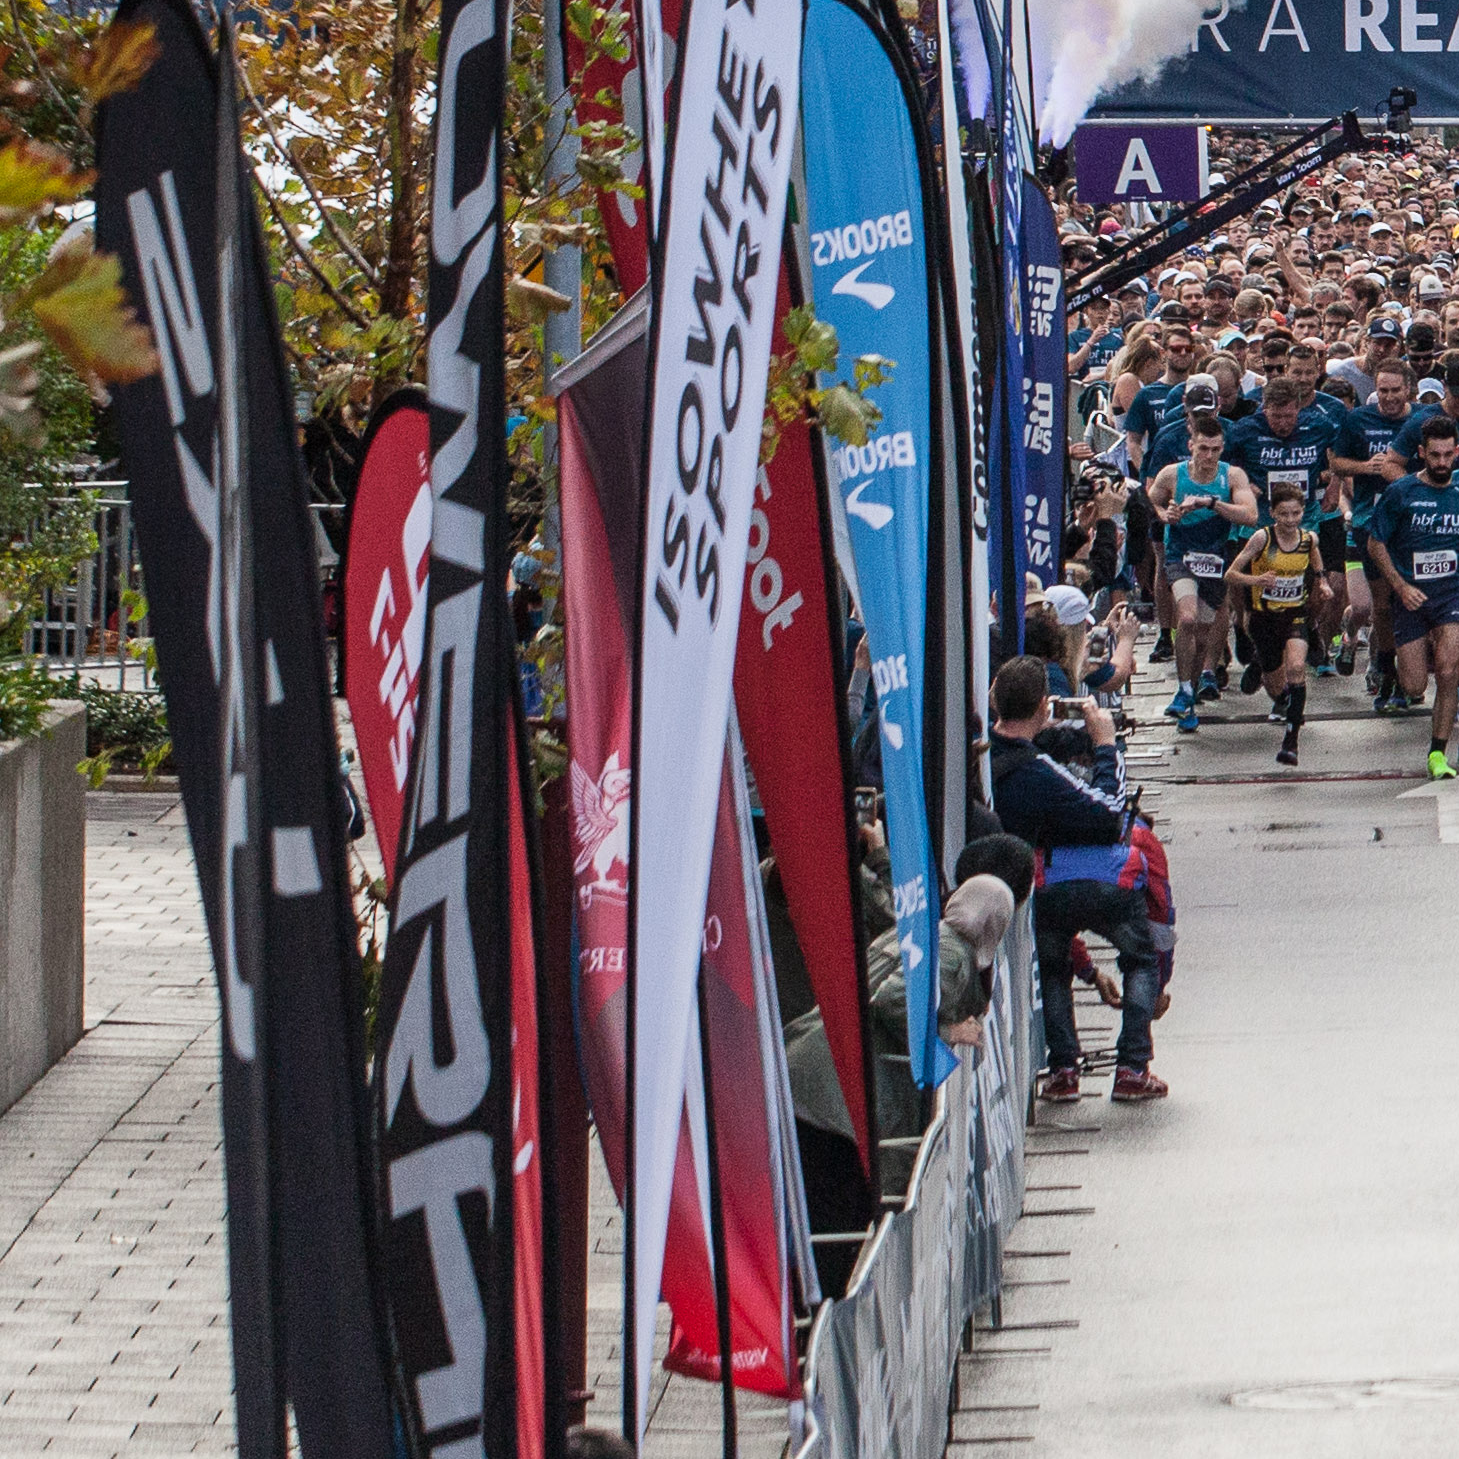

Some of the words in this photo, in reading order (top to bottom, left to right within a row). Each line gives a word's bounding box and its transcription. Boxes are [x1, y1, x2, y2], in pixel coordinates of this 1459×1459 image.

[1115, 138, 1163, 194] A
[696, 56, 786, 634] SPORTS
[1421, 562, 1451, 575] 6219
